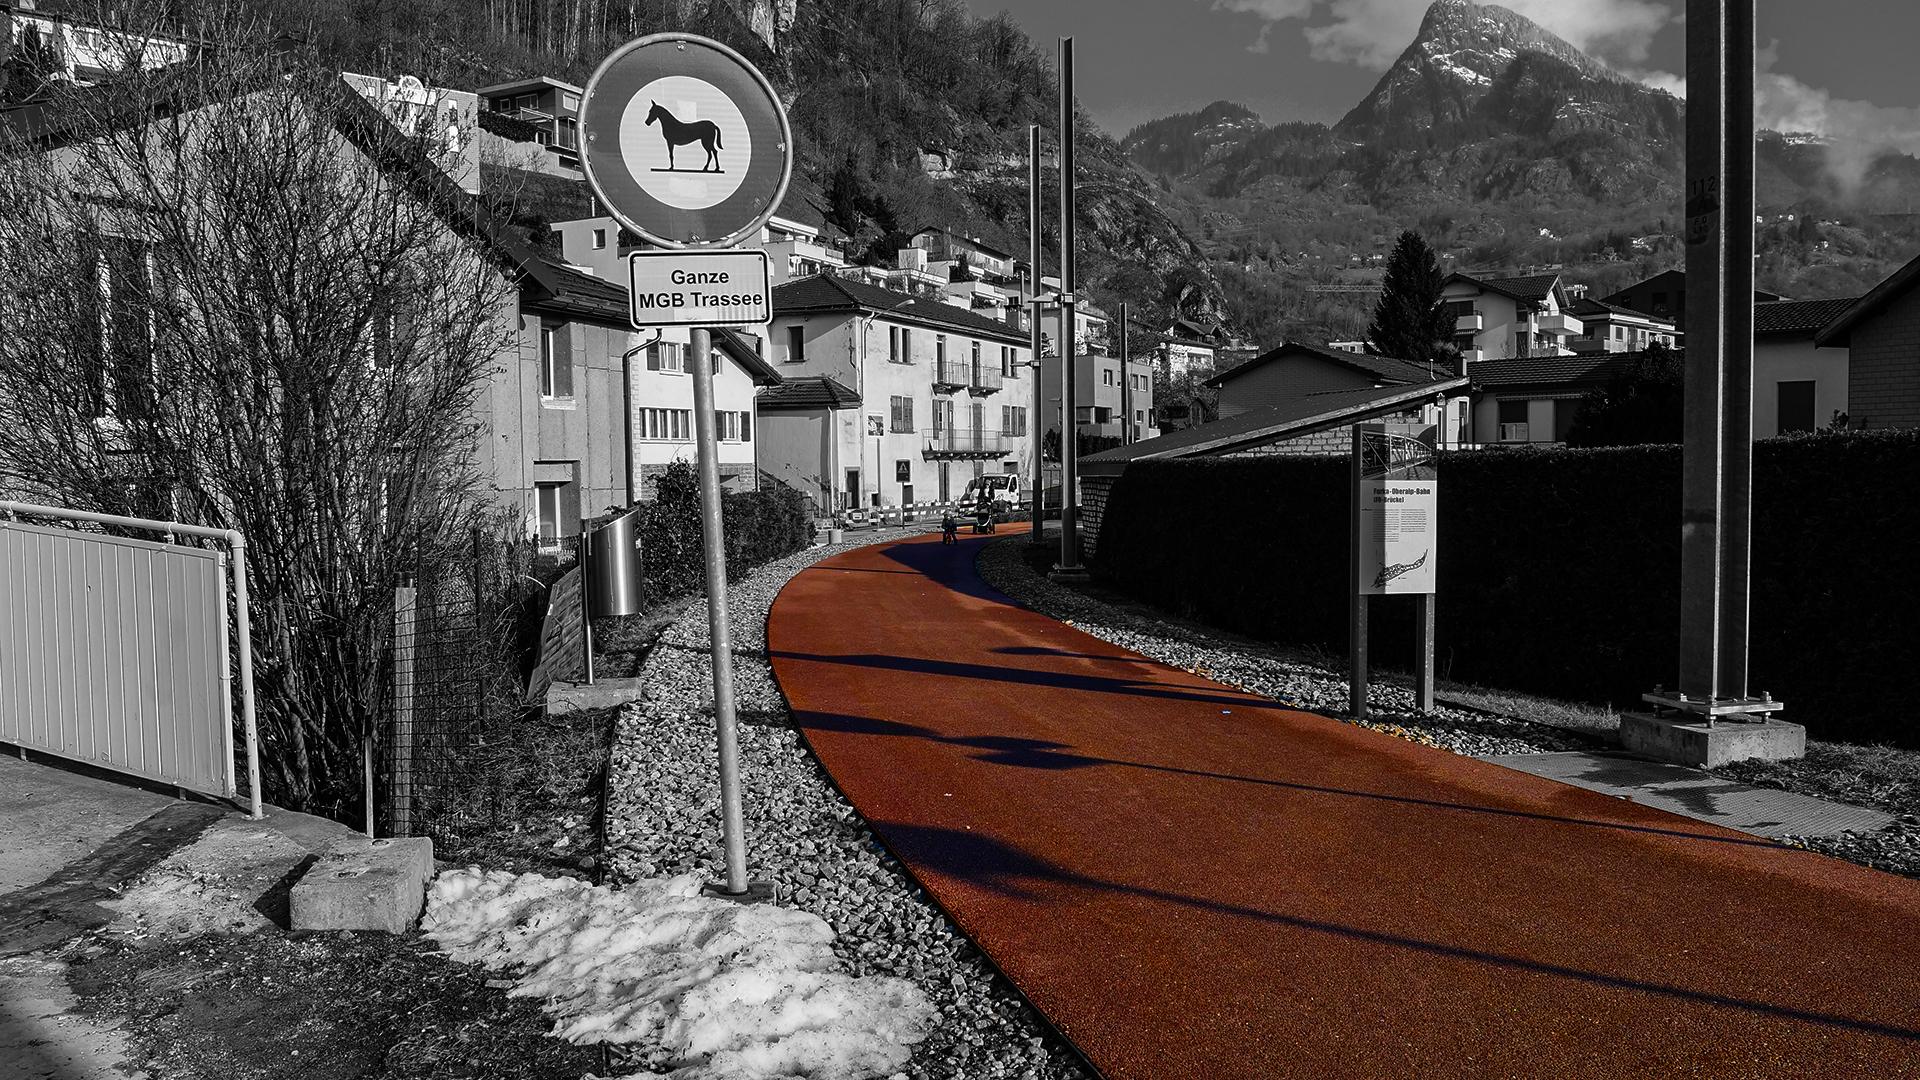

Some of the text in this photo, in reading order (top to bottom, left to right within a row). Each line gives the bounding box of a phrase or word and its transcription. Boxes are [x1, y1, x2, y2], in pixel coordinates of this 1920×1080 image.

[671, 269, 729, 285] Ganze
[639, 292, 763, 308] MGB Trassee
